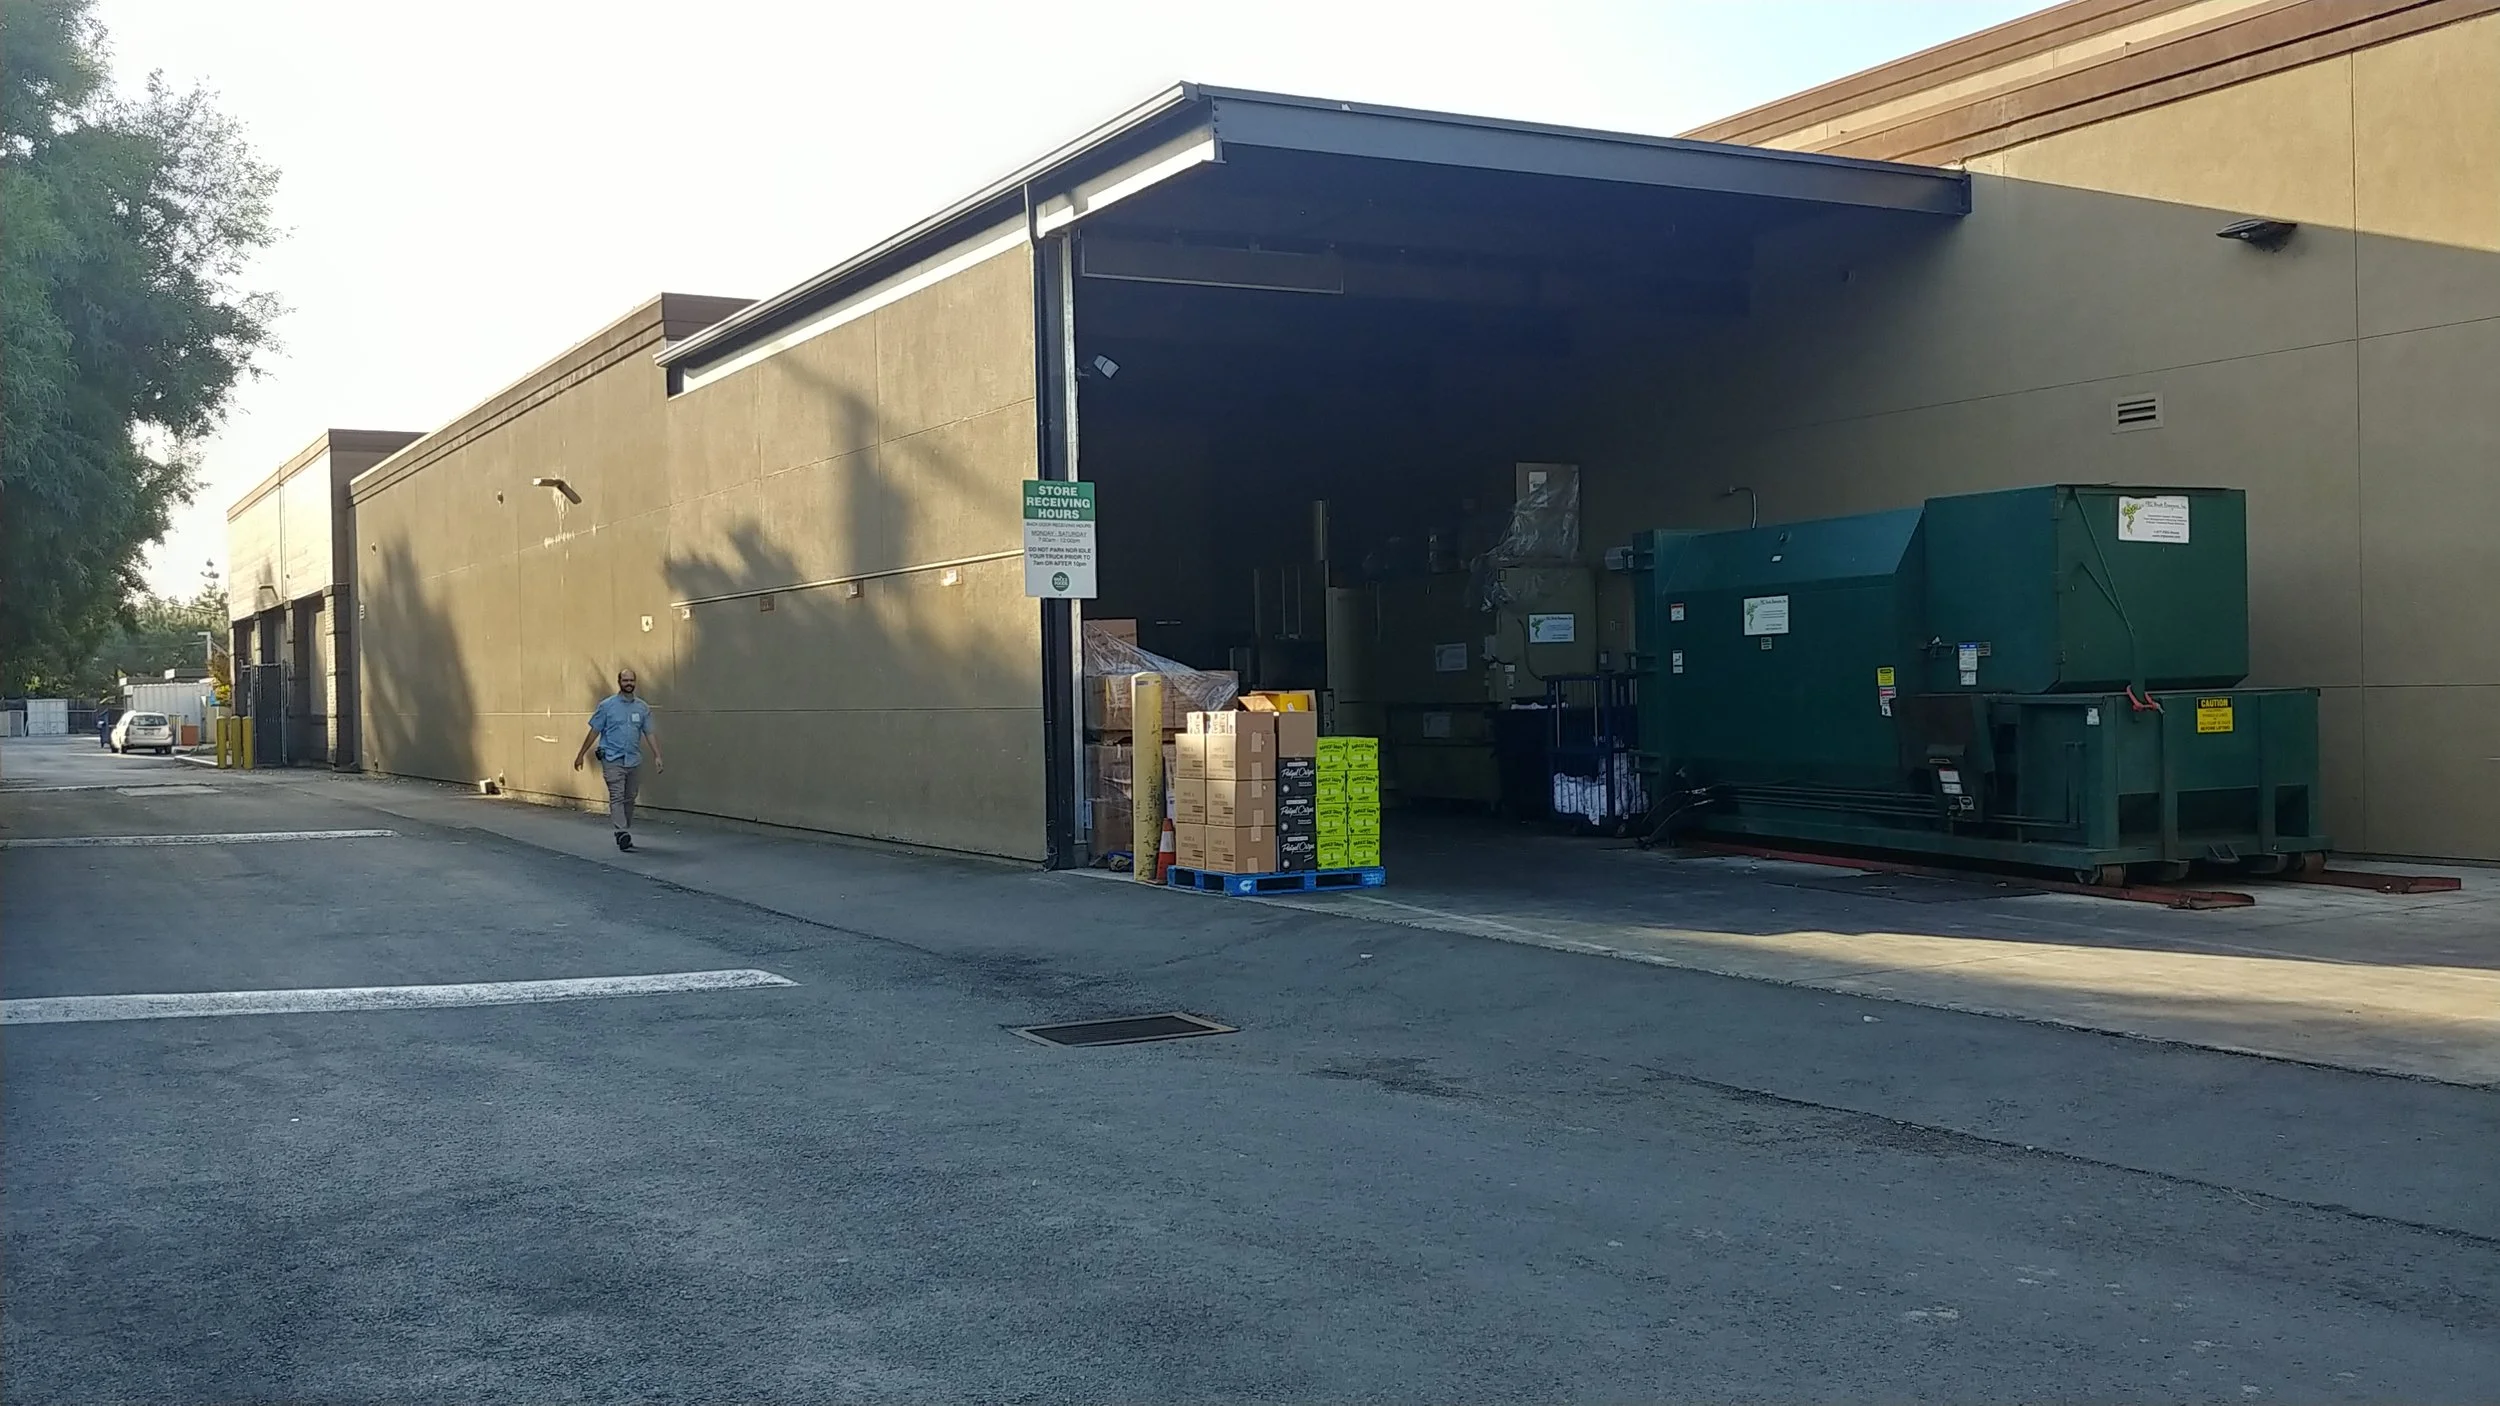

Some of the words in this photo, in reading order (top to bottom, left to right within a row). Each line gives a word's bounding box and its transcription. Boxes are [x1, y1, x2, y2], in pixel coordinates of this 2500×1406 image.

[1038, 485, 1078, 496] STORE
[1026, 496, 1091, 508] RECEIVING
[1038, 508, 1080, 519] HOURS
[2200, 698, 2228, 708] CAUTION
